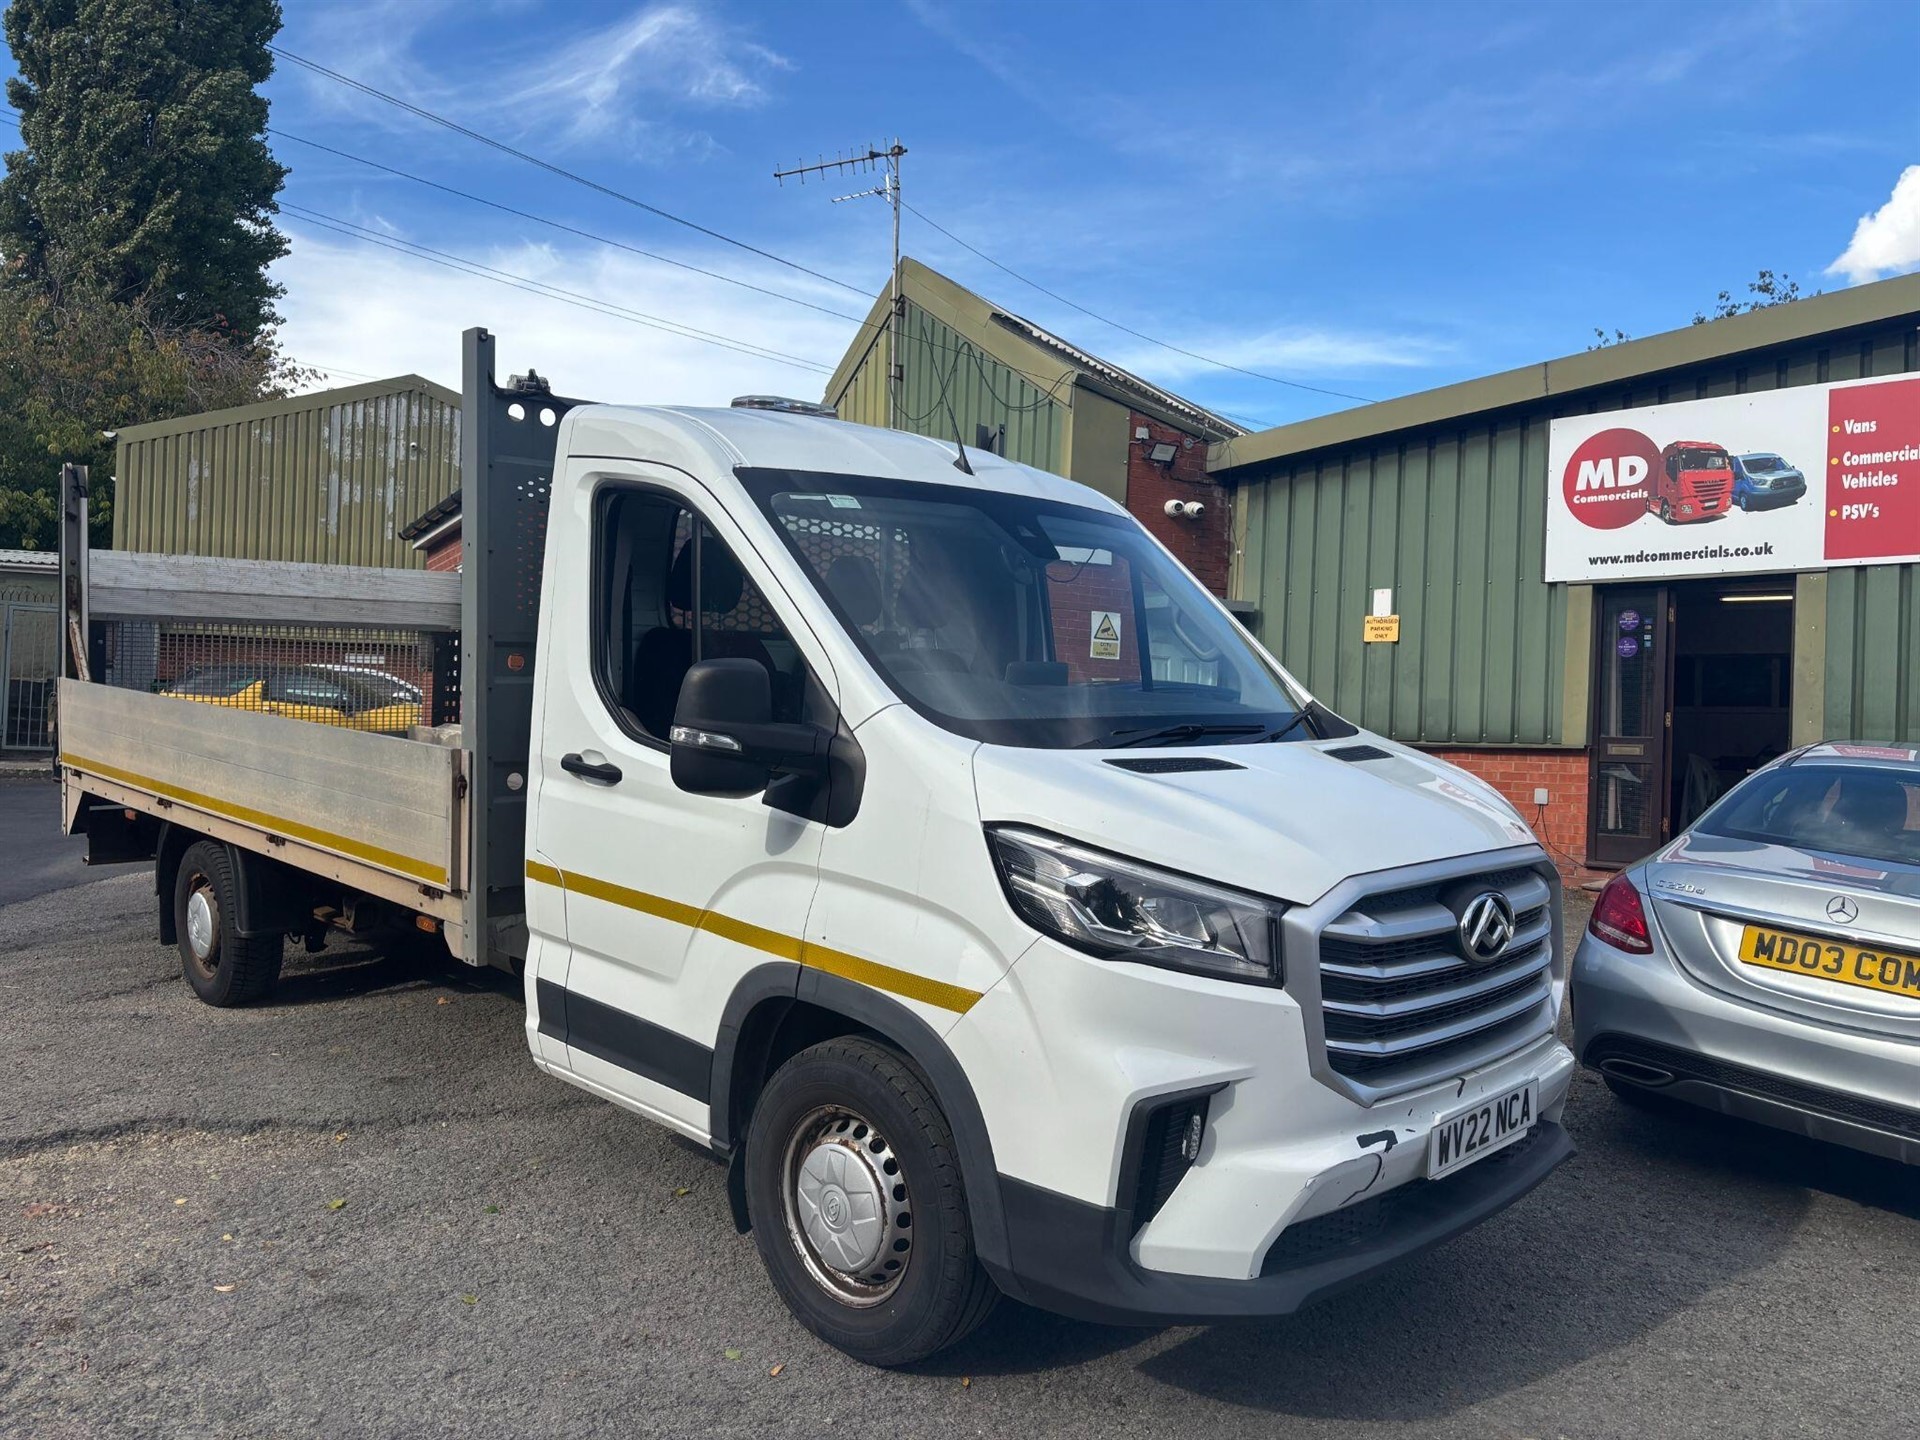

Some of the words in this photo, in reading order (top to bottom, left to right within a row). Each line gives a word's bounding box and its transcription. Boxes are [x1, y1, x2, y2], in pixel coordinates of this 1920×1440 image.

[1844, 419, 1877, 434] Vans
[1575, 455, 1649, 491] MD
[1842, 470, 1898, 489] Vehicles
[1573, 489, 1649, 504] Commercials
[1842, 503, 1880, 520] PSV's
[1588, 542, 1774, 565] www.mdcommercials.co.uk
[1854, 952, 1920, 992] COM
[1438, 1107, 1491, 1167] WV22
[1495, 1088, 1531, 1137] NCA
